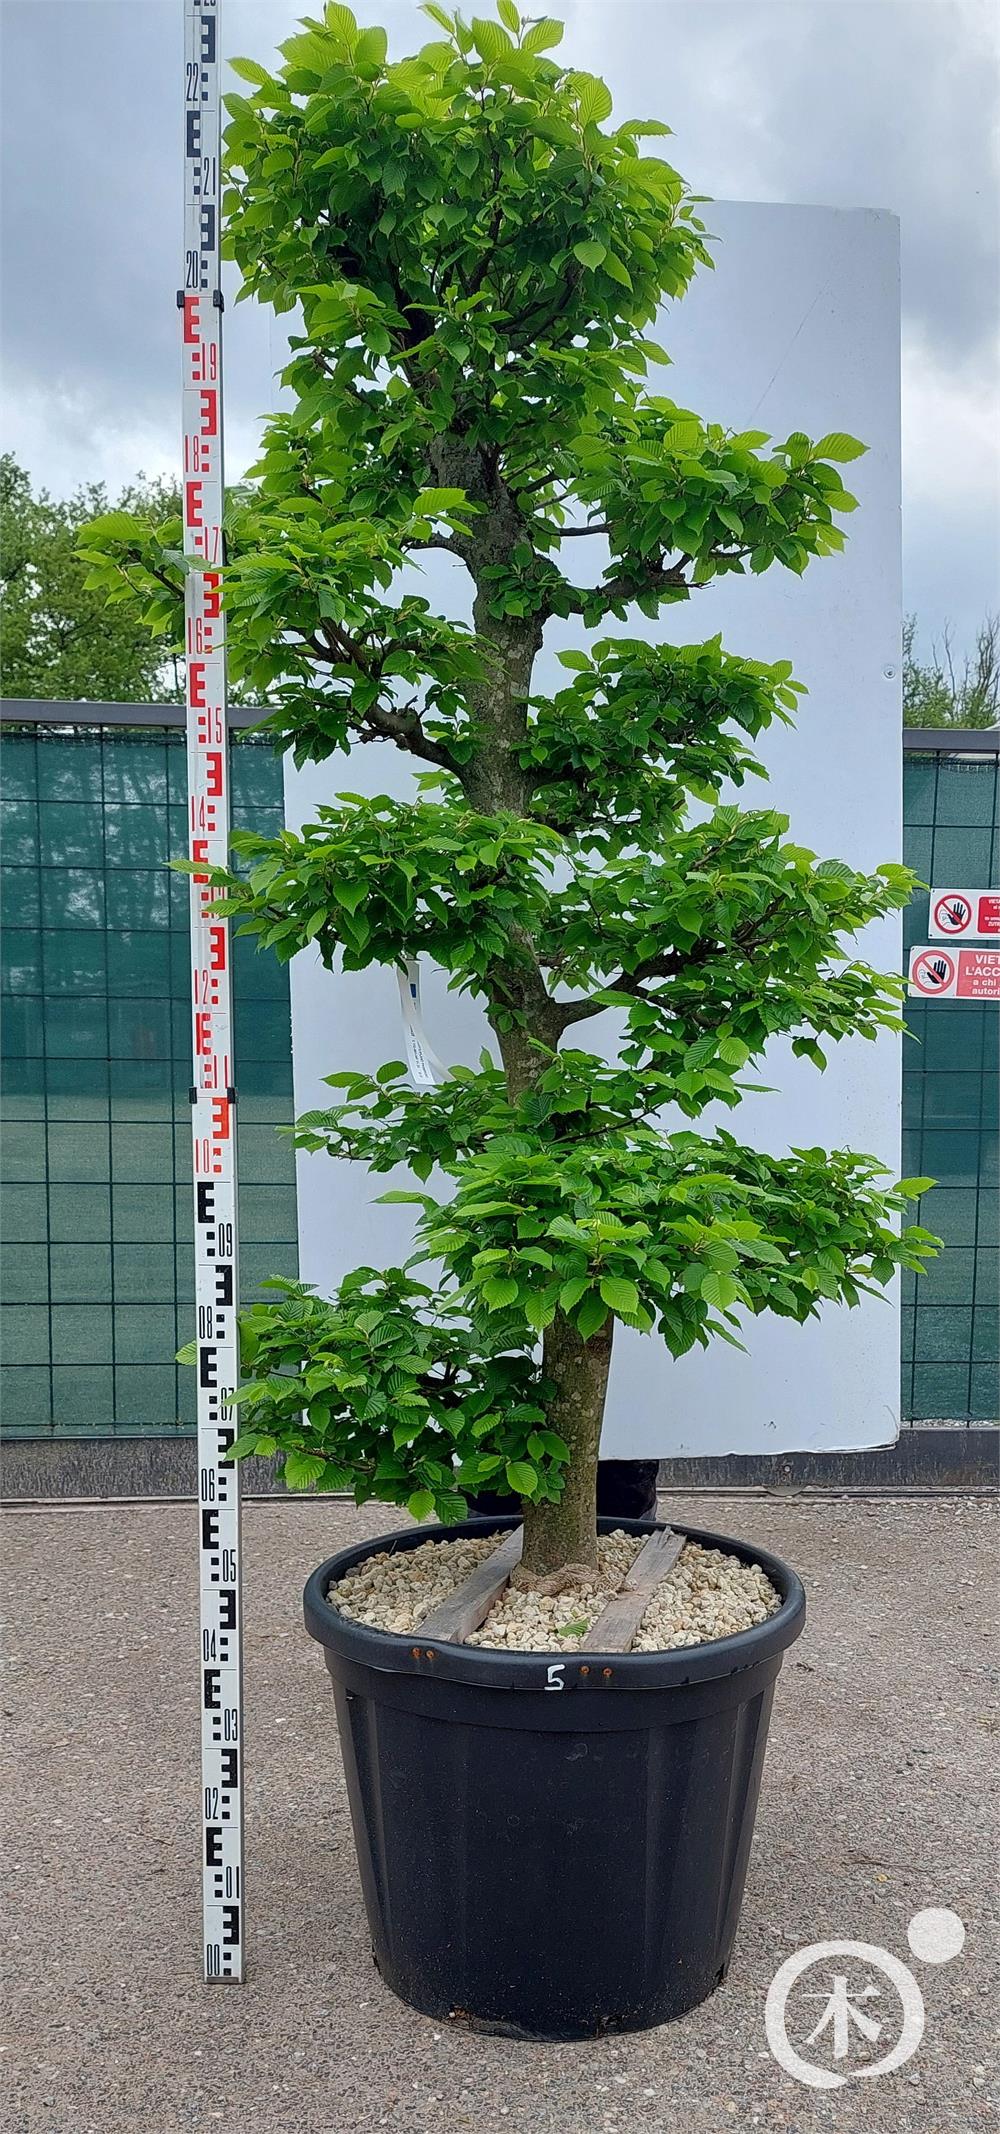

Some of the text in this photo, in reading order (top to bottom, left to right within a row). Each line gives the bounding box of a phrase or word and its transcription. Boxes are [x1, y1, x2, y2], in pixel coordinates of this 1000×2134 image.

[186, 62, 199, 101] 22
[203, 157, 216, 196] 21
[186, 250, 198, 288] 20
[202, 343, 217, 380] 19
[185, 435, 200, 472] 18
[204, 526, 219, 564] 17
[188, 617, 202, 654] 16
[208, 707, 222, 743] 15
[192, 795, 206, 832] 14
[194, 969, 209, 1005] 12
[982, 978, 997, 986] chi
[213, 1055, 228, 1089] 11
[195, 1138, 210, 1173] 10
[218, 1223, 232, 1257] 09
[199, 1305, 213, 1339] 08
[220, 1387, 235, 1421] 07
[201, 1468, 215, 1501] 06
[222, 1549, 237, 1582] 05
[203, 1629, 217, 1662] 04
[544, 1664, 566, 1691] 5
[224, 1708, 238, 1741] 03
[205, 1787, 219, 1820] 02
[226, 1866, 240, 1899] 01
[206, 1943, 220, 1977] 00
